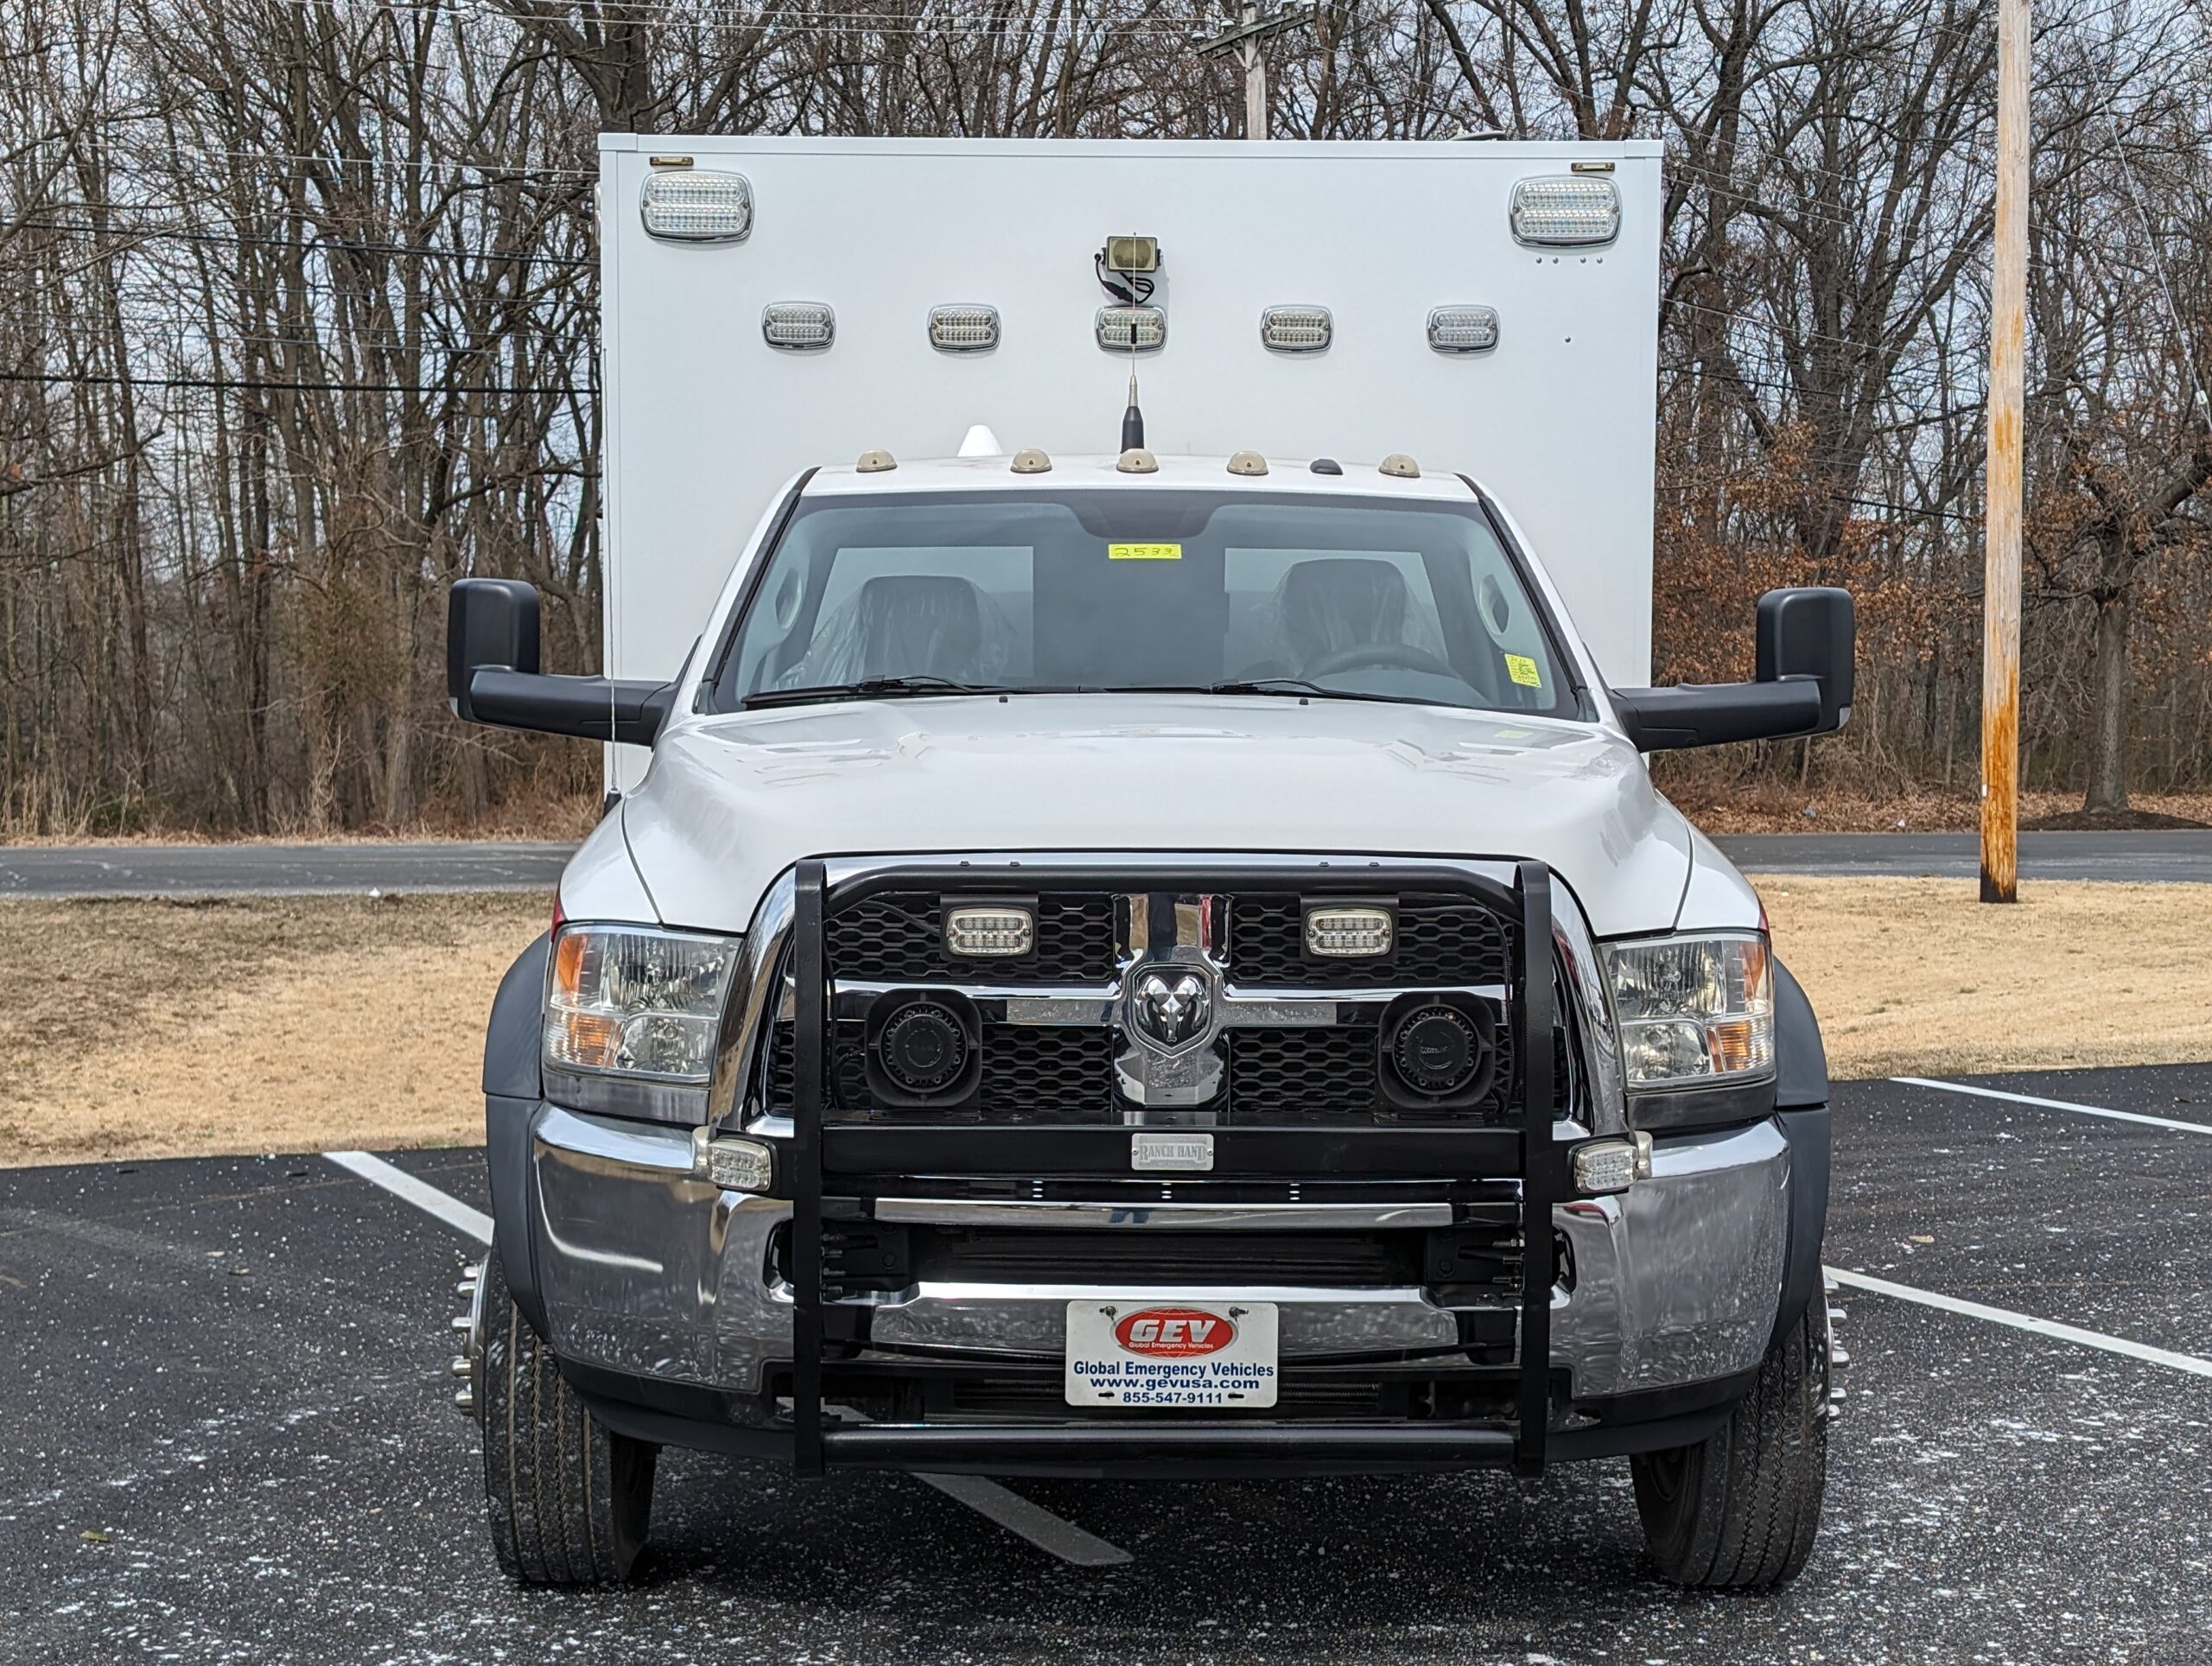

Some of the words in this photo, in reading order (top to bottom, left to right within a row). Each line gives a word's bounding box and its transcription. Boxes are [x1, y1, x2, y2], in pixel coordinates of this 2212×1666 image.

[1139, 1144, 1174, 1160] RANCH
[1177, 1145, 1206, 1161] HAND
[1129, 1319, 1216, 1343] GEV
[1073, 1361, 1120, 1375] Global
[1125, 1361, 1206, 1378] Emergency
[1211, 1363, 1274, 1377] Vehicles
[1090, 1378, 1260, 1390] www.gevusa.com
[1122, 1392, 1223, 1404] 855-547-9111
